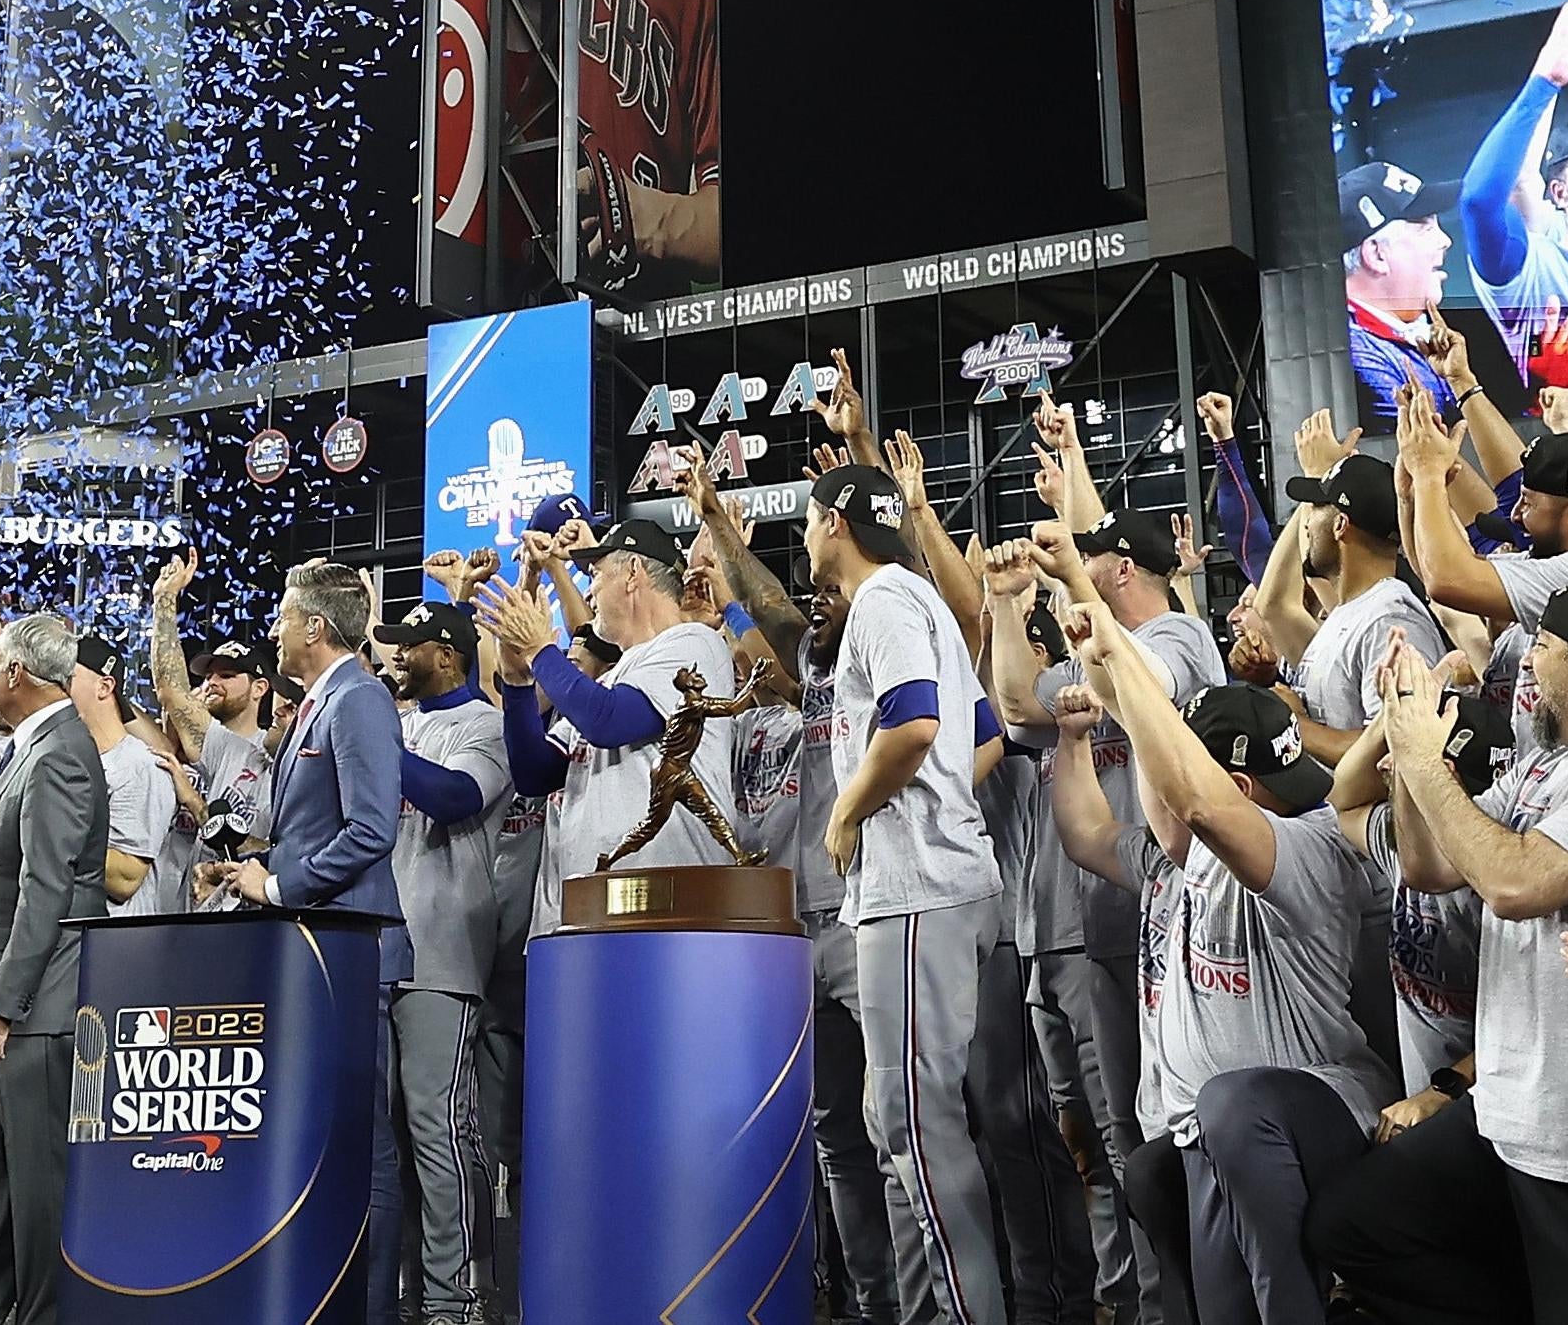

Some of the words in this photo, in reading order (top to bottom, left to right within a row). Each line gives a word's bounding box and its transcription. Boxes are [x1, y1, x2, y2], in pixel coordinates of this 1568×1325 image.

[903, 257, 980, 291] WORLD
[987, 233, 1126, 273] CHAMPIONS
[623, 309, 649, 336] NL
[657, 299, 716, 330] WEST
[723, 278, 852, 319] CHAMPIONS
[961, 332, 1005, 368] World
[1006, 330, 1073, 362] Champions
[815, 369, 835, 388] 02
[995, 361, 1041, 384] 2001
[672, 392, 692, 409] 99
[743, 381, 761, 398] 01
[336, 428, 354, 442] JOE
[745, 438, 761, 455] 11
[438, 470, 575, 512] CHAMPIONS
[739, 488, 798, 519] CARD
[173, 1012, 265, 1036] 2023
[114, 1047, 264, 1089] WORLD
[112, 1087, 265, 1134] SERIES
